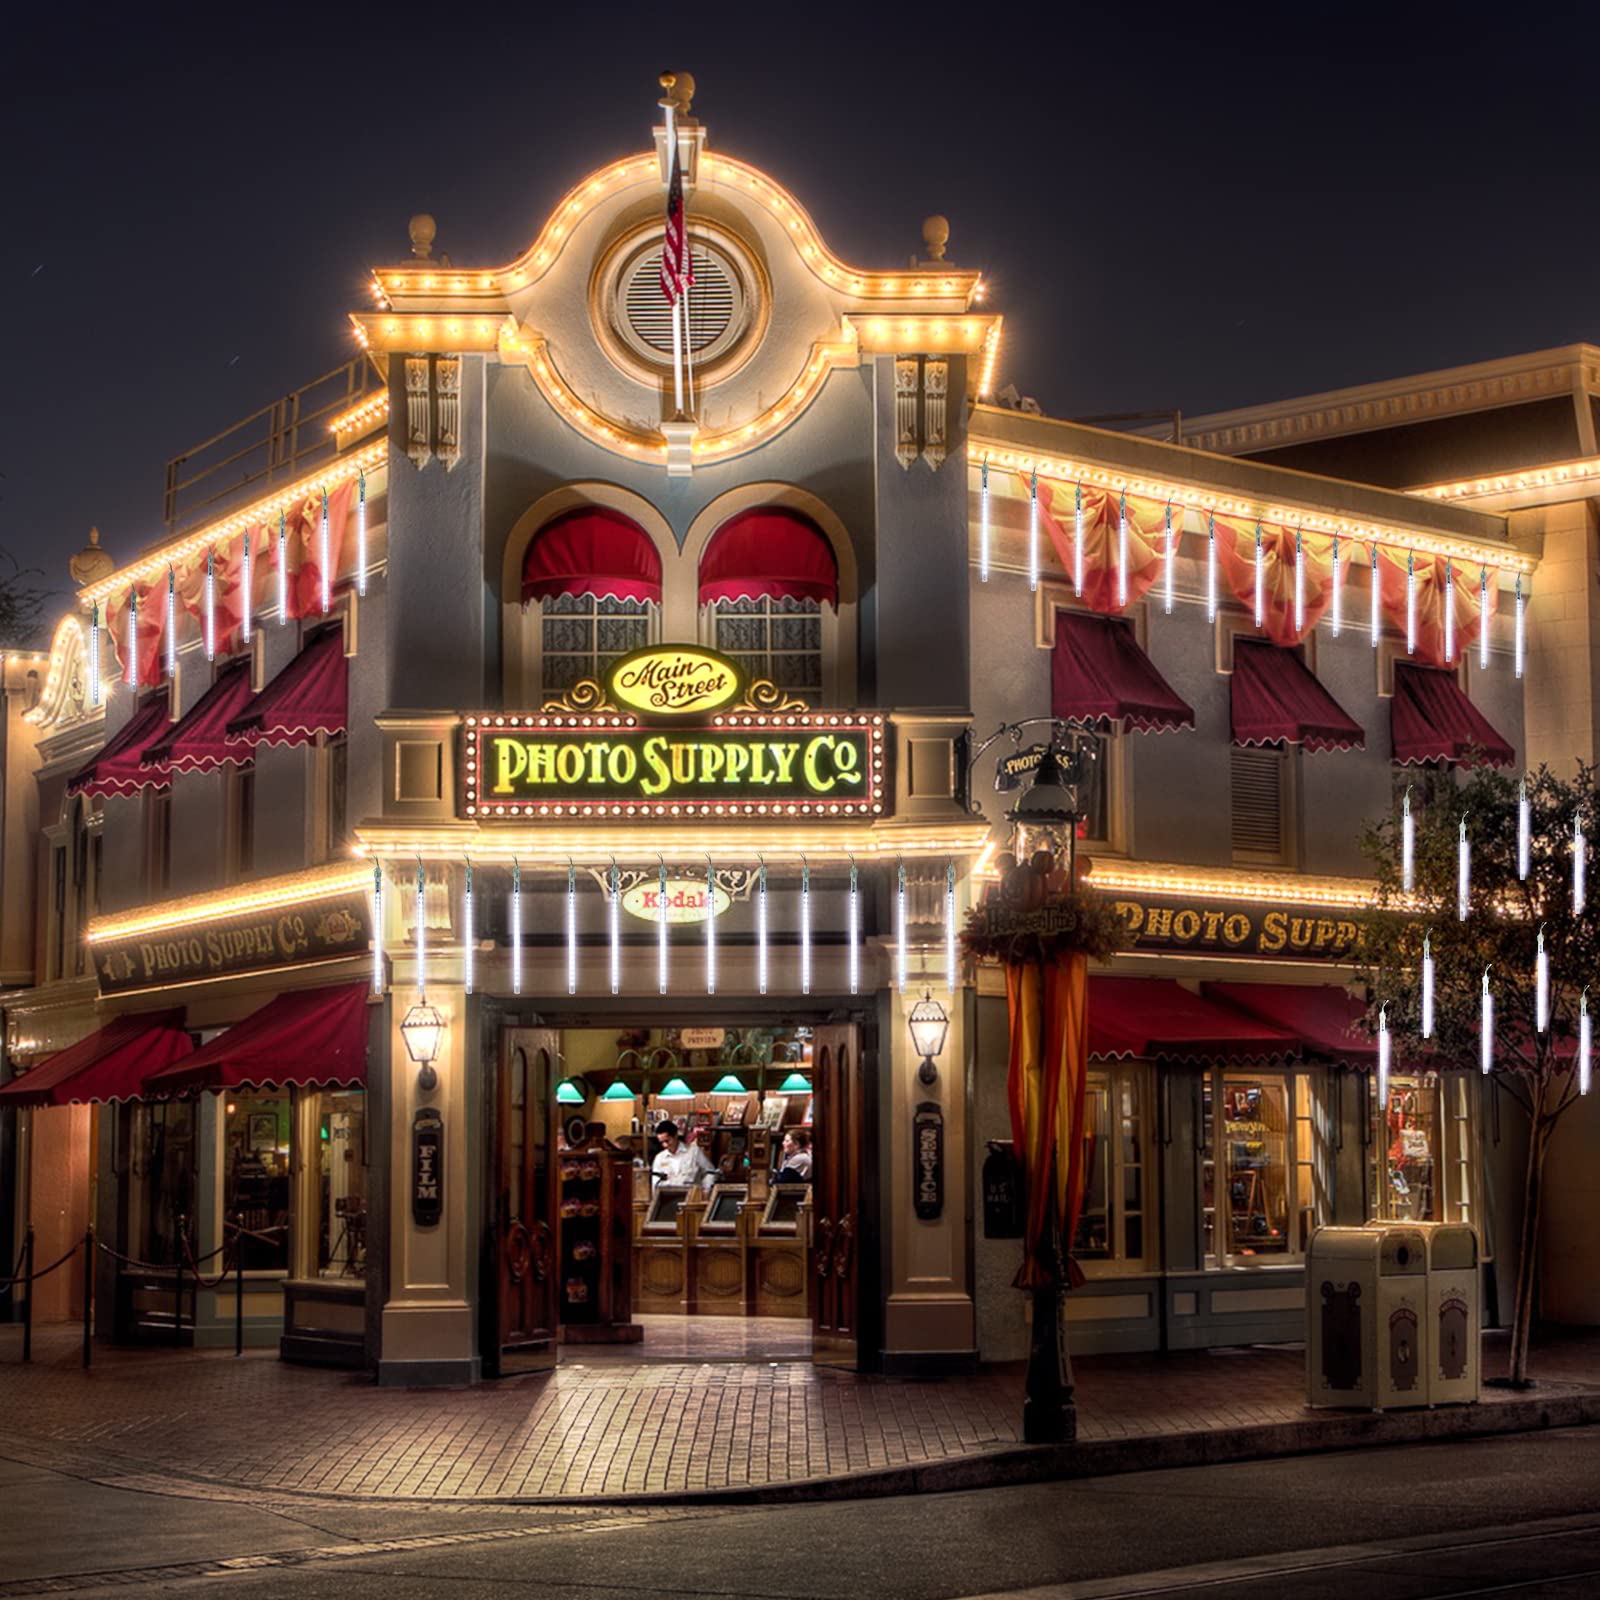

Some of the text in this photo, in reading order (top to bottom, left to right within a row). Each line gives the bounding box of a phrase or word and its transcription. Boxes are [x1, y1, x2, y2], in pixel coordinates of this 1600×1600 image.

[620, 657, 713, 689] Main
[650, 673, 727, 708] Street
[493, 738, 637, 793] PHOTO
[640, 736, 800, 795] SUPPLY
[1259, 912, 1369, 949] SUPP
[418, 1145, 438, 1199] FILM
[920, 1129, 937, 1202] SERVICE
